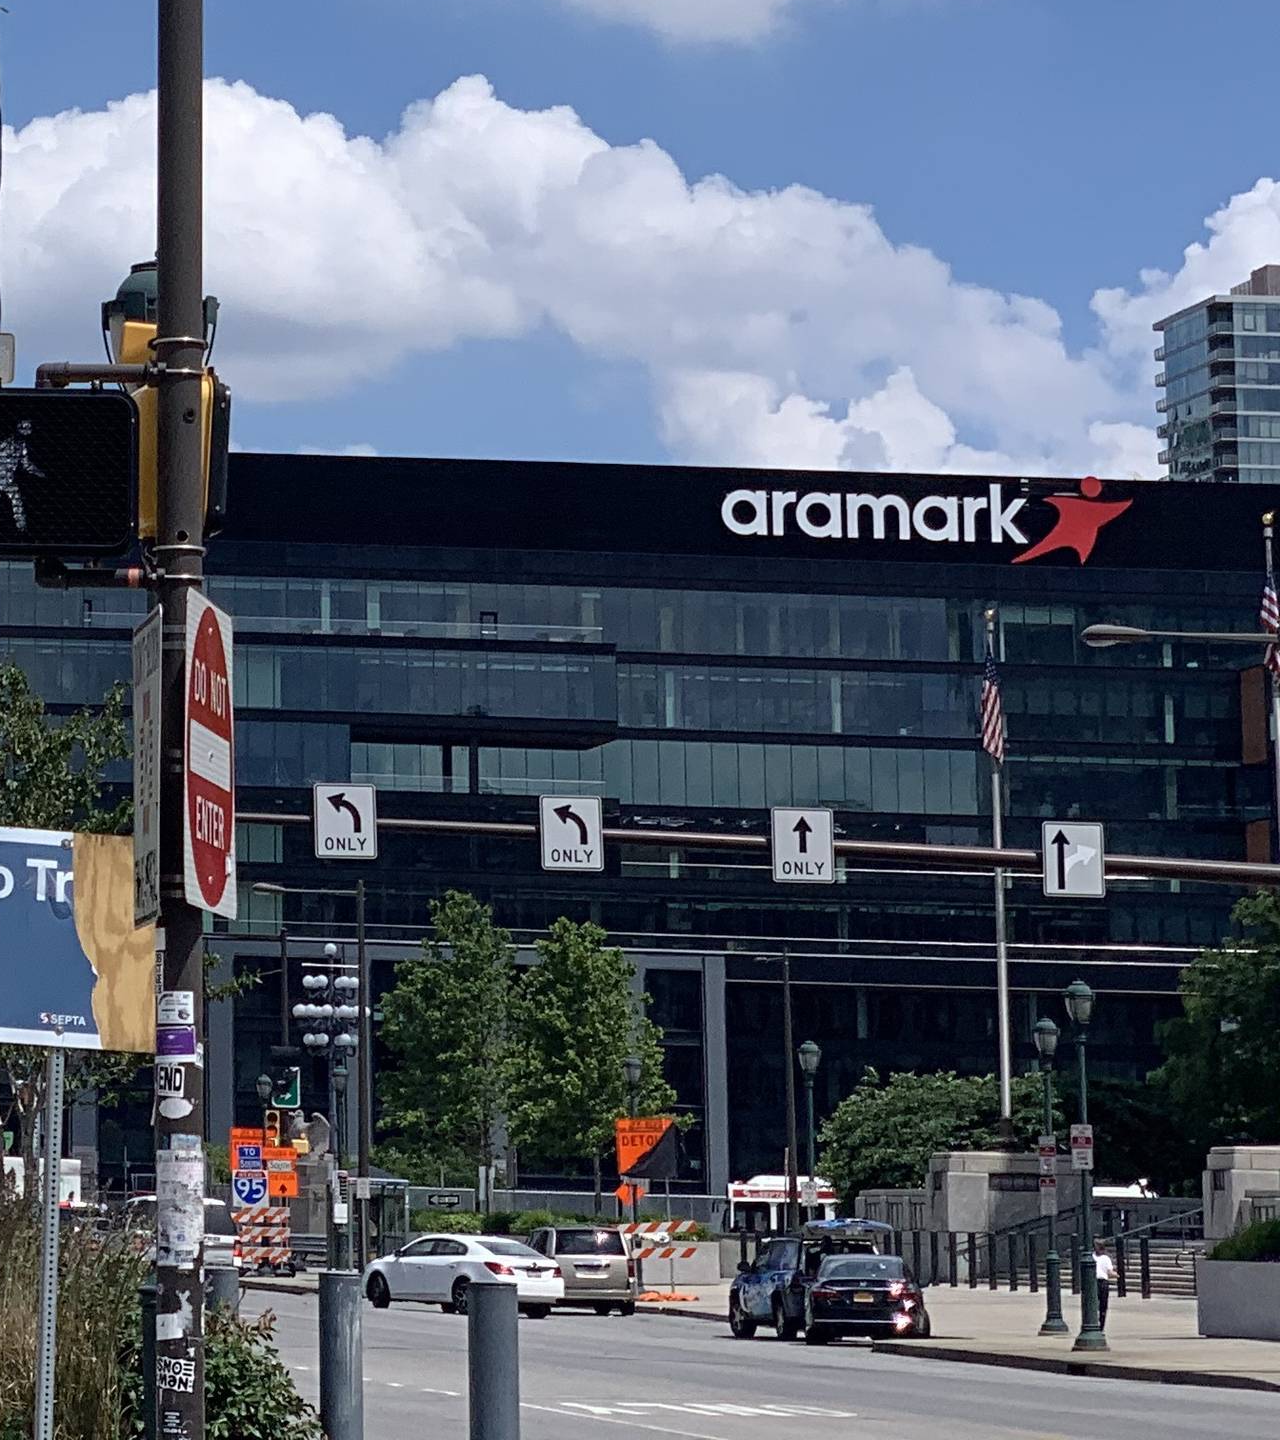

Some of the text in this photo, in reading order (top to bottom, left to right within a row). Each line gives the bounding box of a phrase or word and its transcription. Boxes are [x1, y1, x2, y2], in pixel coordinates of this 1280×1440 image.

[721, 482, 1029, 545] aramark
[194, 658, 227, 720] DO NOT
[196, 795, 225, 850] ENTER
[325, 837, 367, 851] ONLY
[551, 848, 594, 863] ONLY
[782, 861, 825, 875] ONLY
[50, 1014, 86, 1026] SEPTA
[244, 1148, 256, 1156] TO
[237, 1179, 264, 1199] 95
